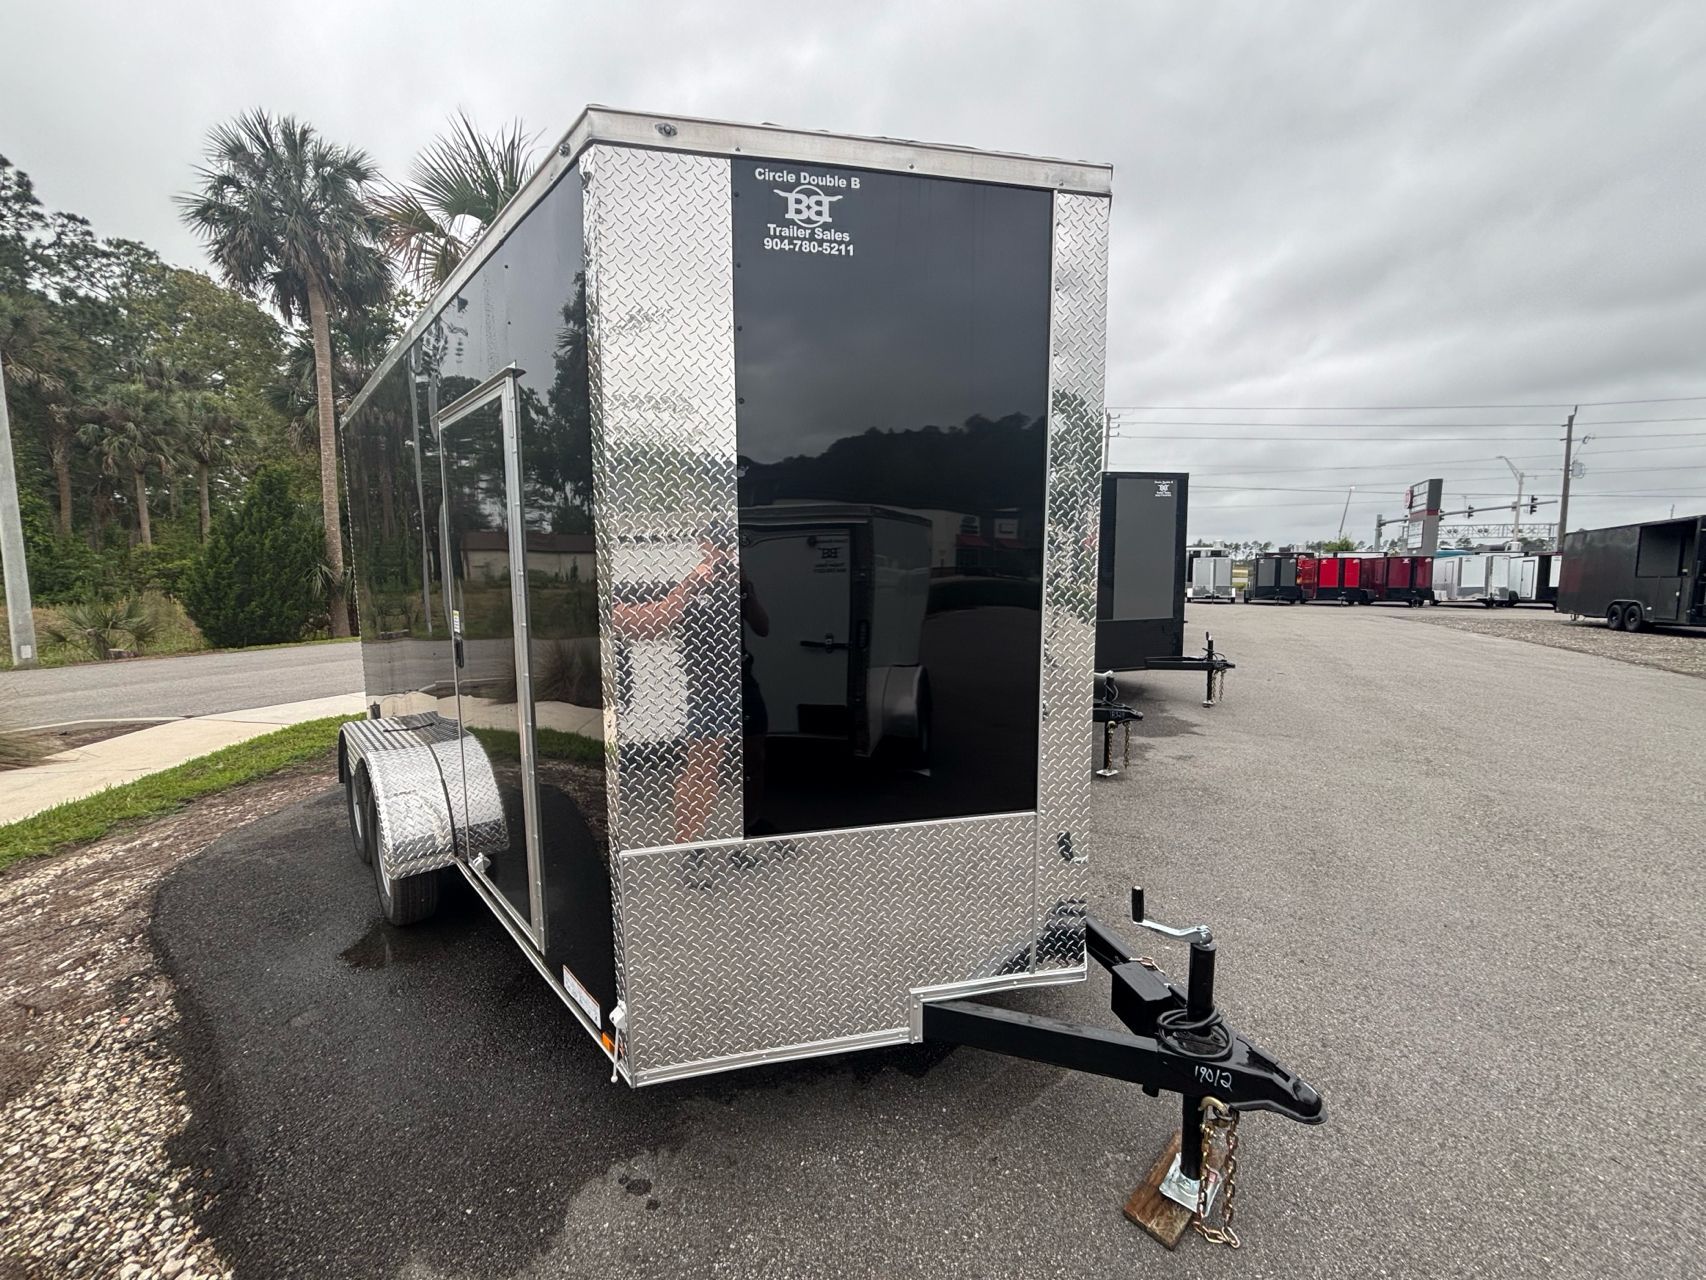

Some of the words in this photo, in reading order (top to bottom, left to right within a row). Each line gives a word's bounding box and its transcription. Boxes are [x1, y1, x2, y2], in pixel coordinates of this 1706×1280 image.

[754, 168, 796, 182] Circle
[800, 172, 847, 188] Double
[850, 177, 861, 189] B
[767, 223, 811, 238] Trailer
[814, 227, 850, 242] Sales
[763, 237, 855, 256] 904-780-5211
[1194, 1065, 1233, 1092] 19012
